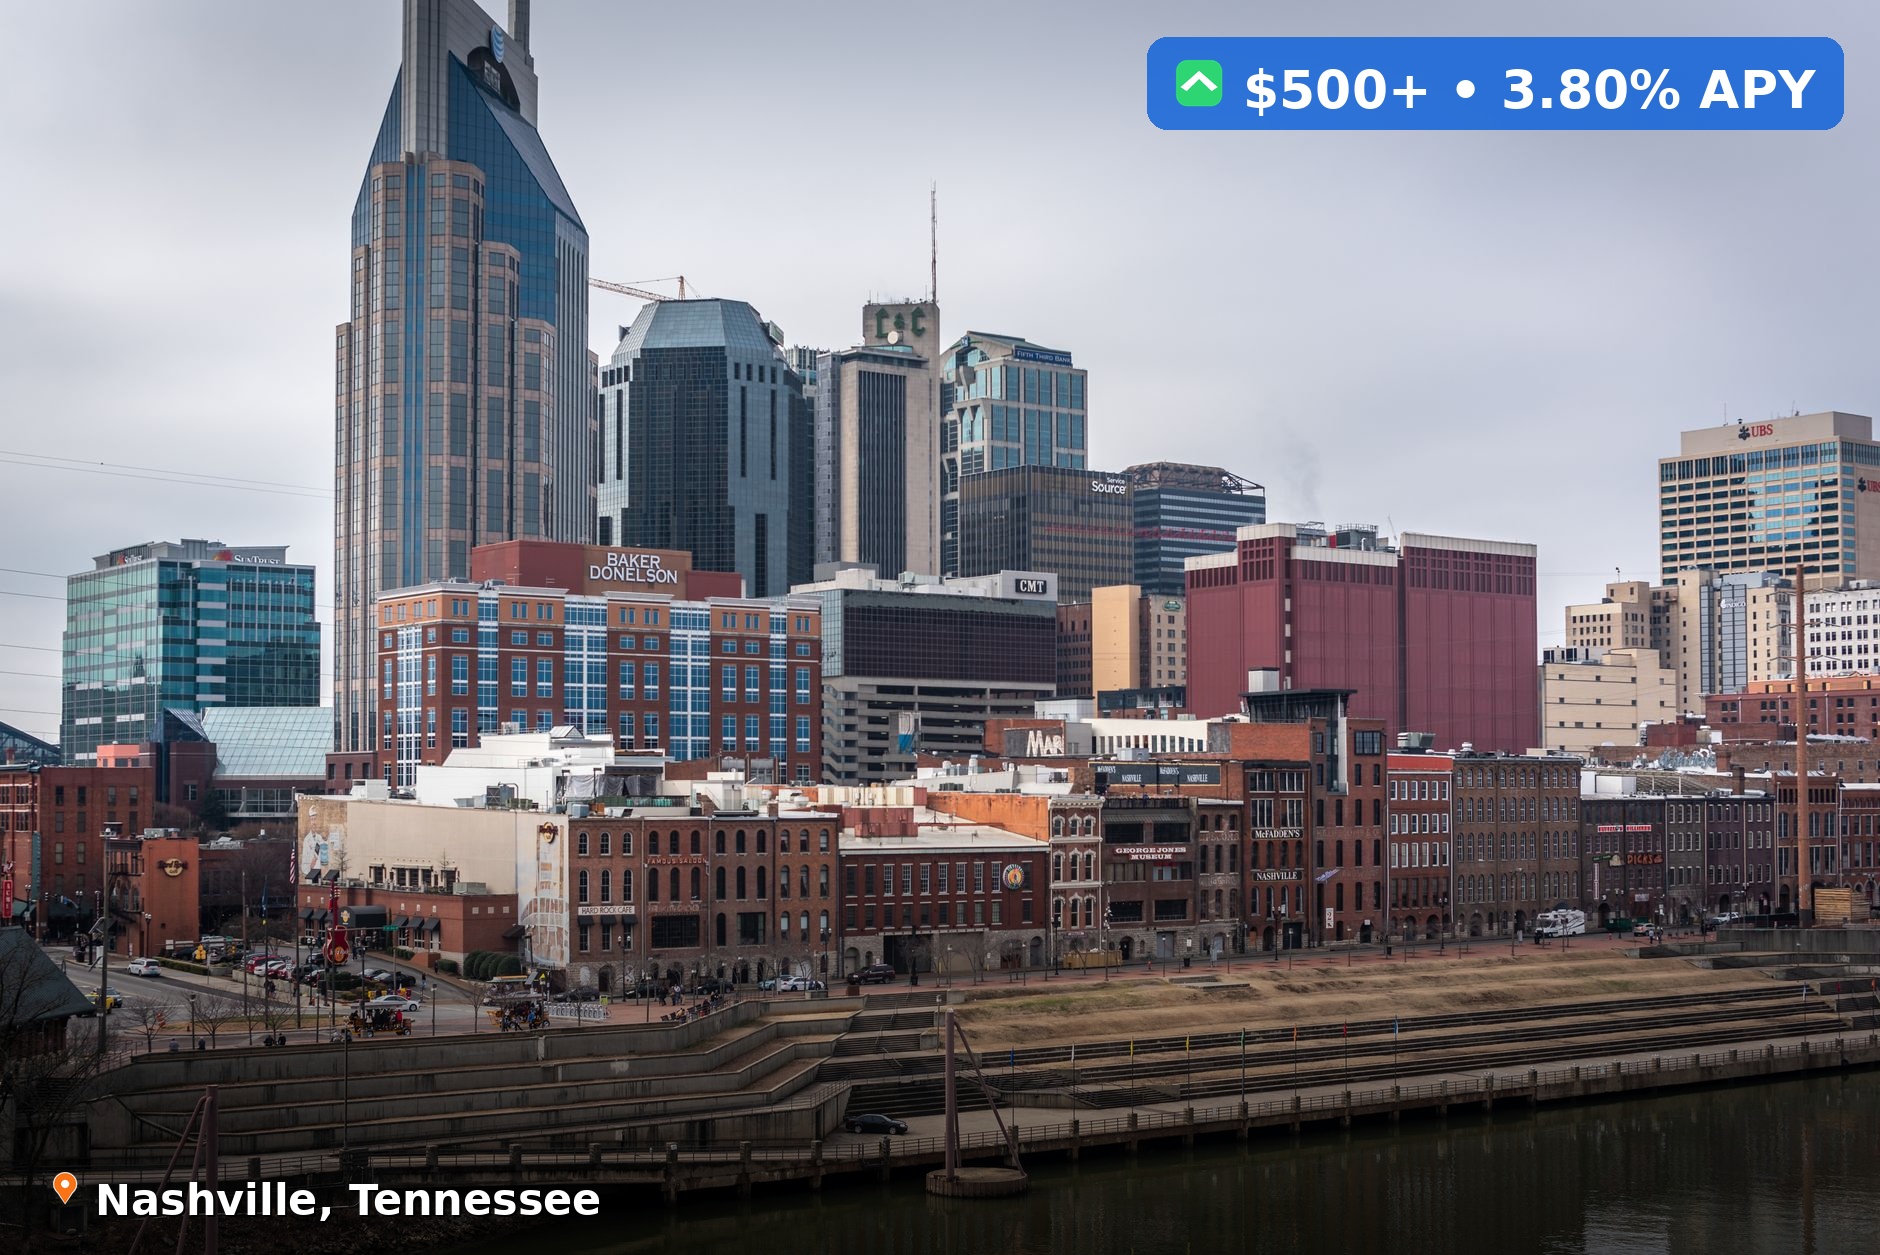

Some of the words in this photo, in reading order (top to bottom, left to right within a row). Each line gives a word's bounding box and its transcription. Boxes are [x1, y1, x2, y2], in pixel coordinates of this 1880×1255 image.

[1017, 350, 1034, 359] FIFTH
[1035, 352, 1054, 361] THIRD
[1054, 355, 1071, 364] BANK
[1751, 424, 1773, 437] UBS
[1106, 476, 1126, 485] Service
[1091, 480, 1126, 495] Source
[607, 552, 660, 569] BAKER
[590, 565, 678, 584] DONELSON
[1020, 579, 1044, 593] CMT
[1122, 774, 1142, 783] NASHVILLE
[1187, 774, 1208, 783] NASHVILLE
[1255, 829, 1301, 839] McFADDEN'S
[647, 858, 676, 866] FAMOUS
[679, 857, 707, 865] SALOON
[1256, 871, 1298, 881] NASHVILLE
